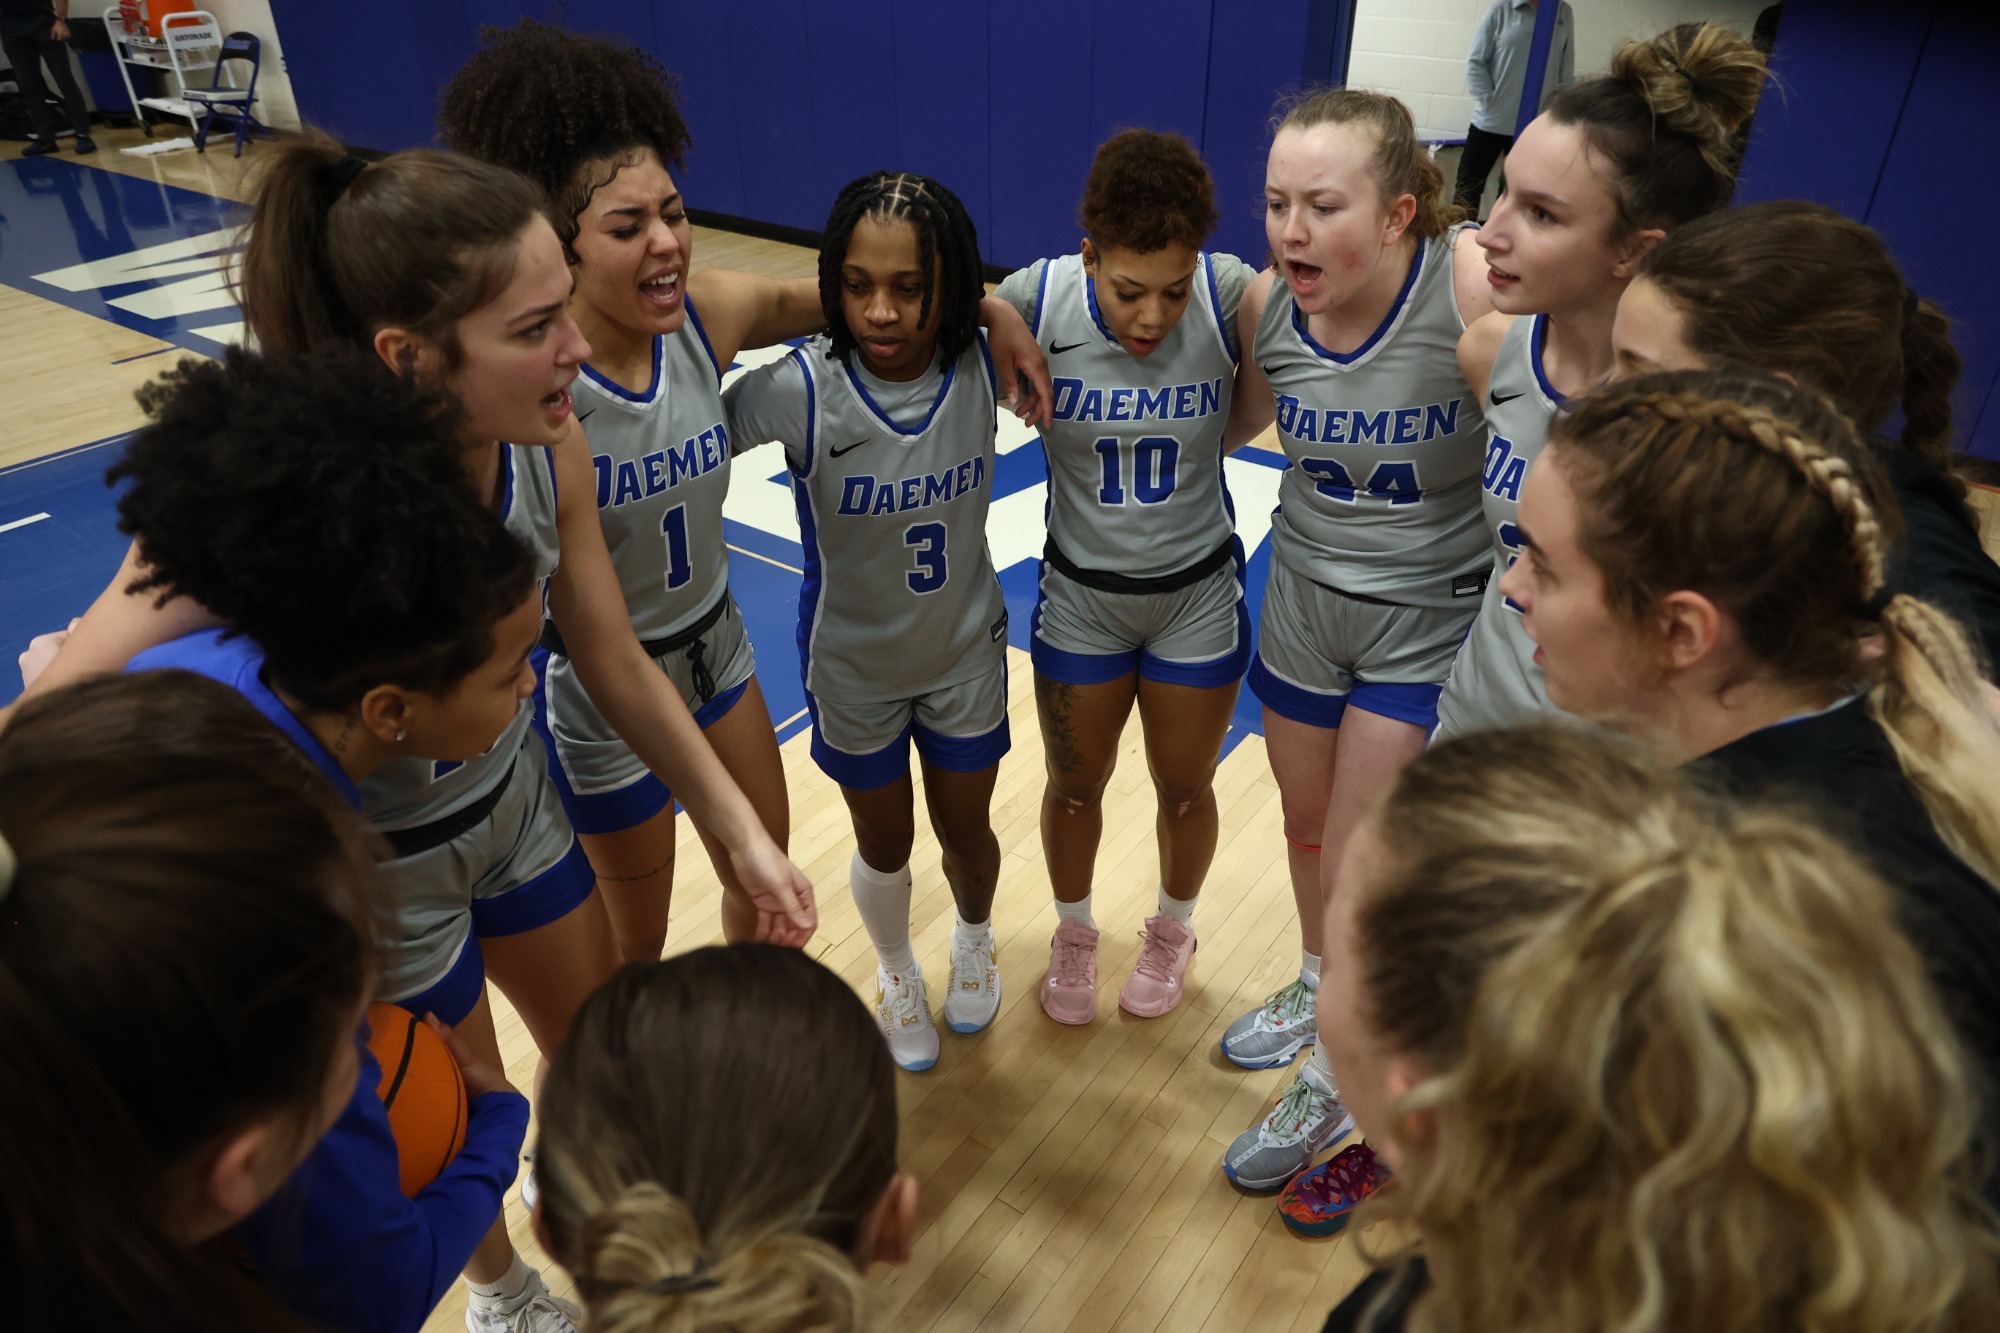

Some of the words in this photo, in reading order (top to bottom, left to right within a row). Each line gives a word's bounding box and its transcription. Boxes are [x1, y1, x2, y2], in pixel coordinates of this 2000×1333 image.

[1053, 376, 1223, 423] DAEMEN
[1276, 394, 1463, 445] DAEMEN
[835, 454, 985, 516] DAEMEN
[1092, 434, 1182, 507] 10
[660, 501, 692, 592] 1
[903, 520, 949, 595] 3
